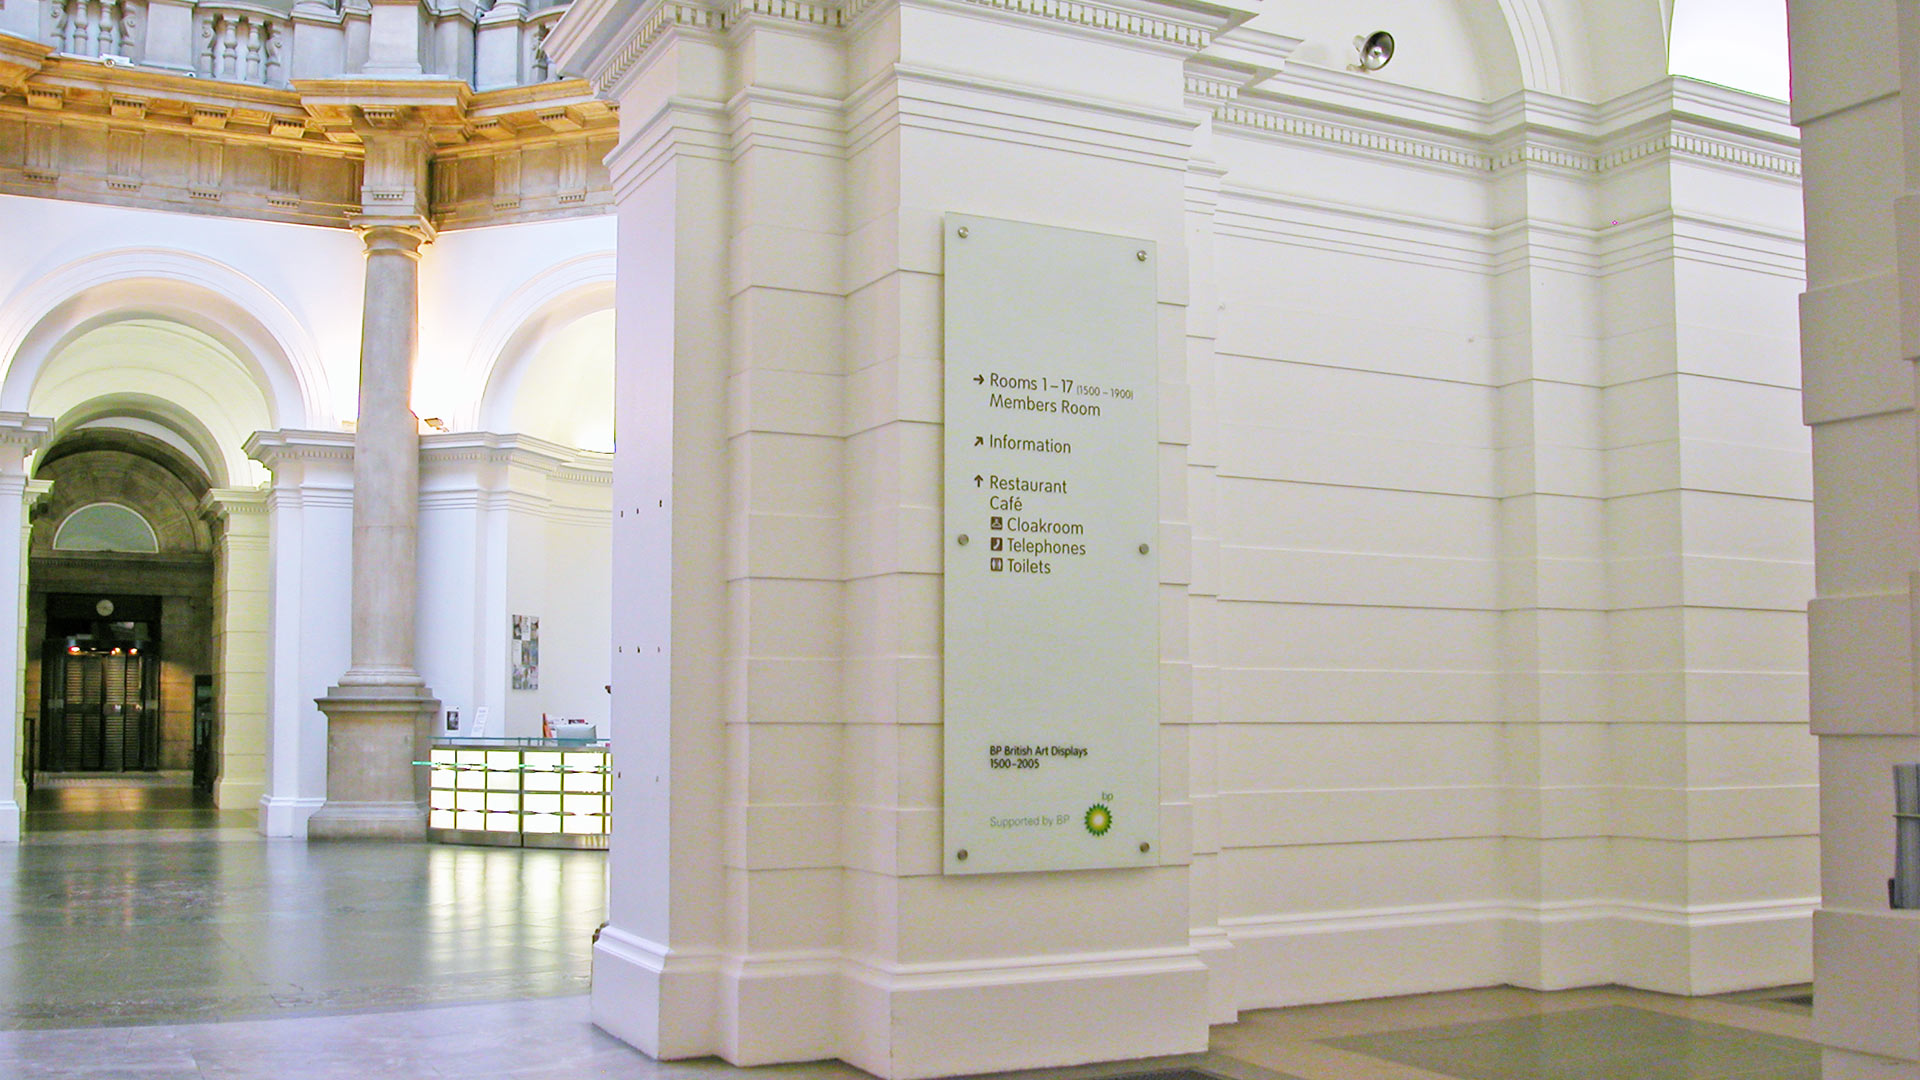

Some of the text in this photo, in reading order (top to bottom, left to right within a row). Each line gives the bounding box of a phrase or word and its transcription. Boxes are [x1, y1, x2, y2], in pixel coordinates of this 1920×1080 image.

[990, 373, 1038, 391] Rooms
[989, 394, 1101, 416] Members Room
[989, 434, 1071, 454] Information
[990, 475, 1067, 494] Restaurant
[990, 495, 1023, 511] Café
[1007, 517, 1084, 536] Cloakroom
[1007, 537, 1086, 556] Telephones
[1007, 558, 1051, 575] Toilets
[989, 745, 1088, 758] BP British Art Displays
[1102, 792, 1114, 803] bp
[989, 815, 1070, 829] Supported by BP
